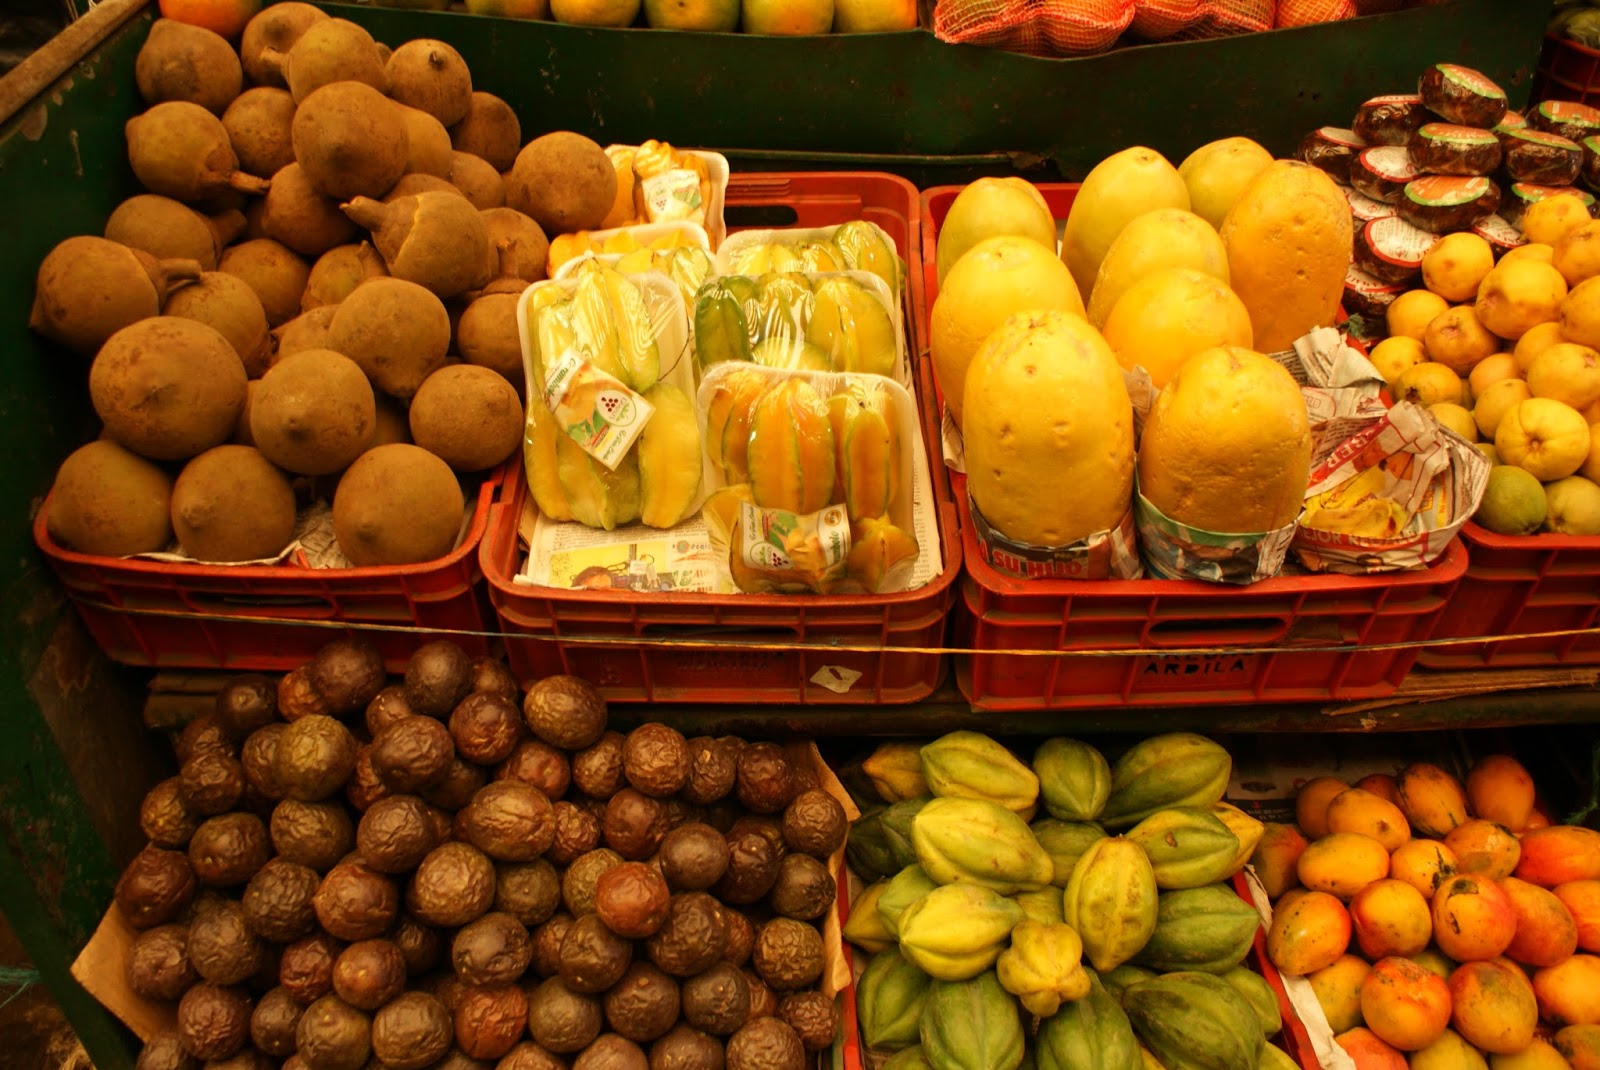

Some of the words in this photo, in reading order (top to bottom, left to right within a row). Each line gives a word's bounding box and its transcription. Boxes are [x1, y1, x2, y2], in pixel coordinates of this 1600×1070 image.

[992, 549, 1020, 573] SU
[1026, 560, 1083, 577] HIJO
[1144, 659, 1244, 675] ARDILA
